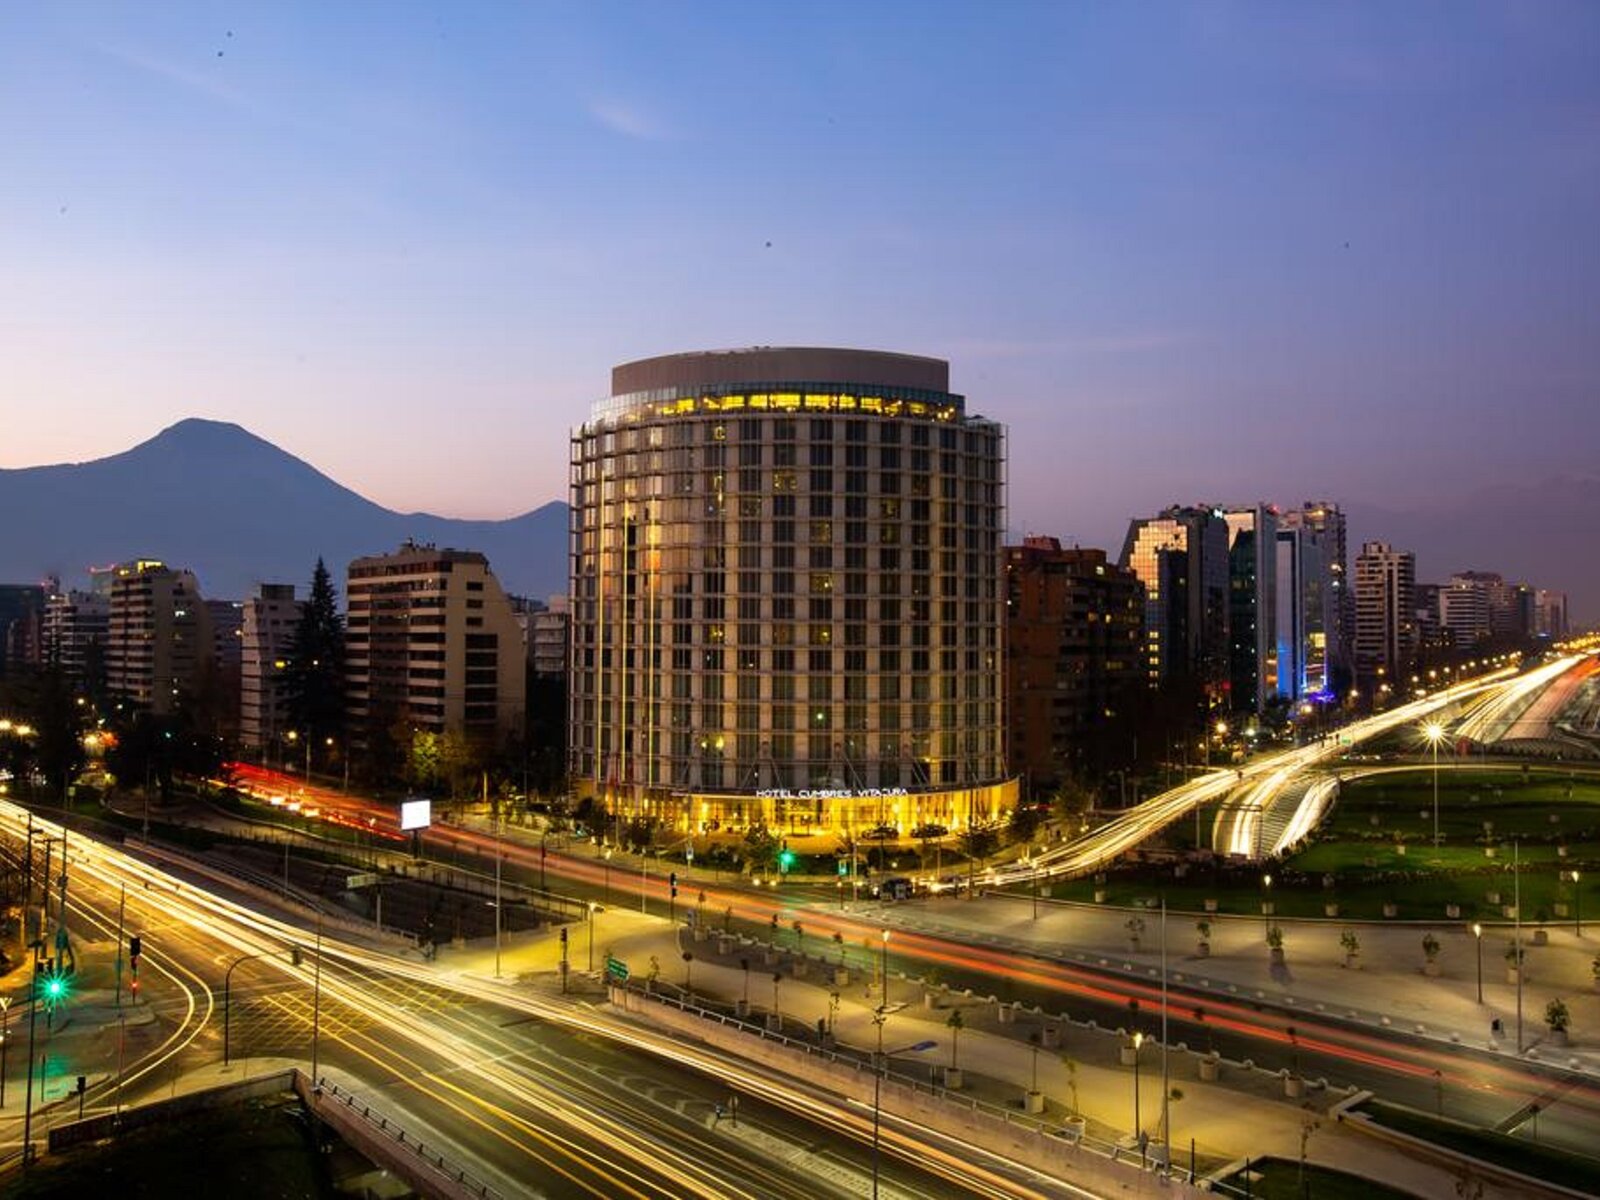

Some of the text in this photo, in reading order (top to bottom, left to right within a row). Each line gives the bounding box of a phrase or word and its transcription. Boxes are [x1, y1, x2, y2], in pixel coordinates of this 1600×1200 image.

[756, 788, 909, 798] HOTEL CUMBRES VITACURA
